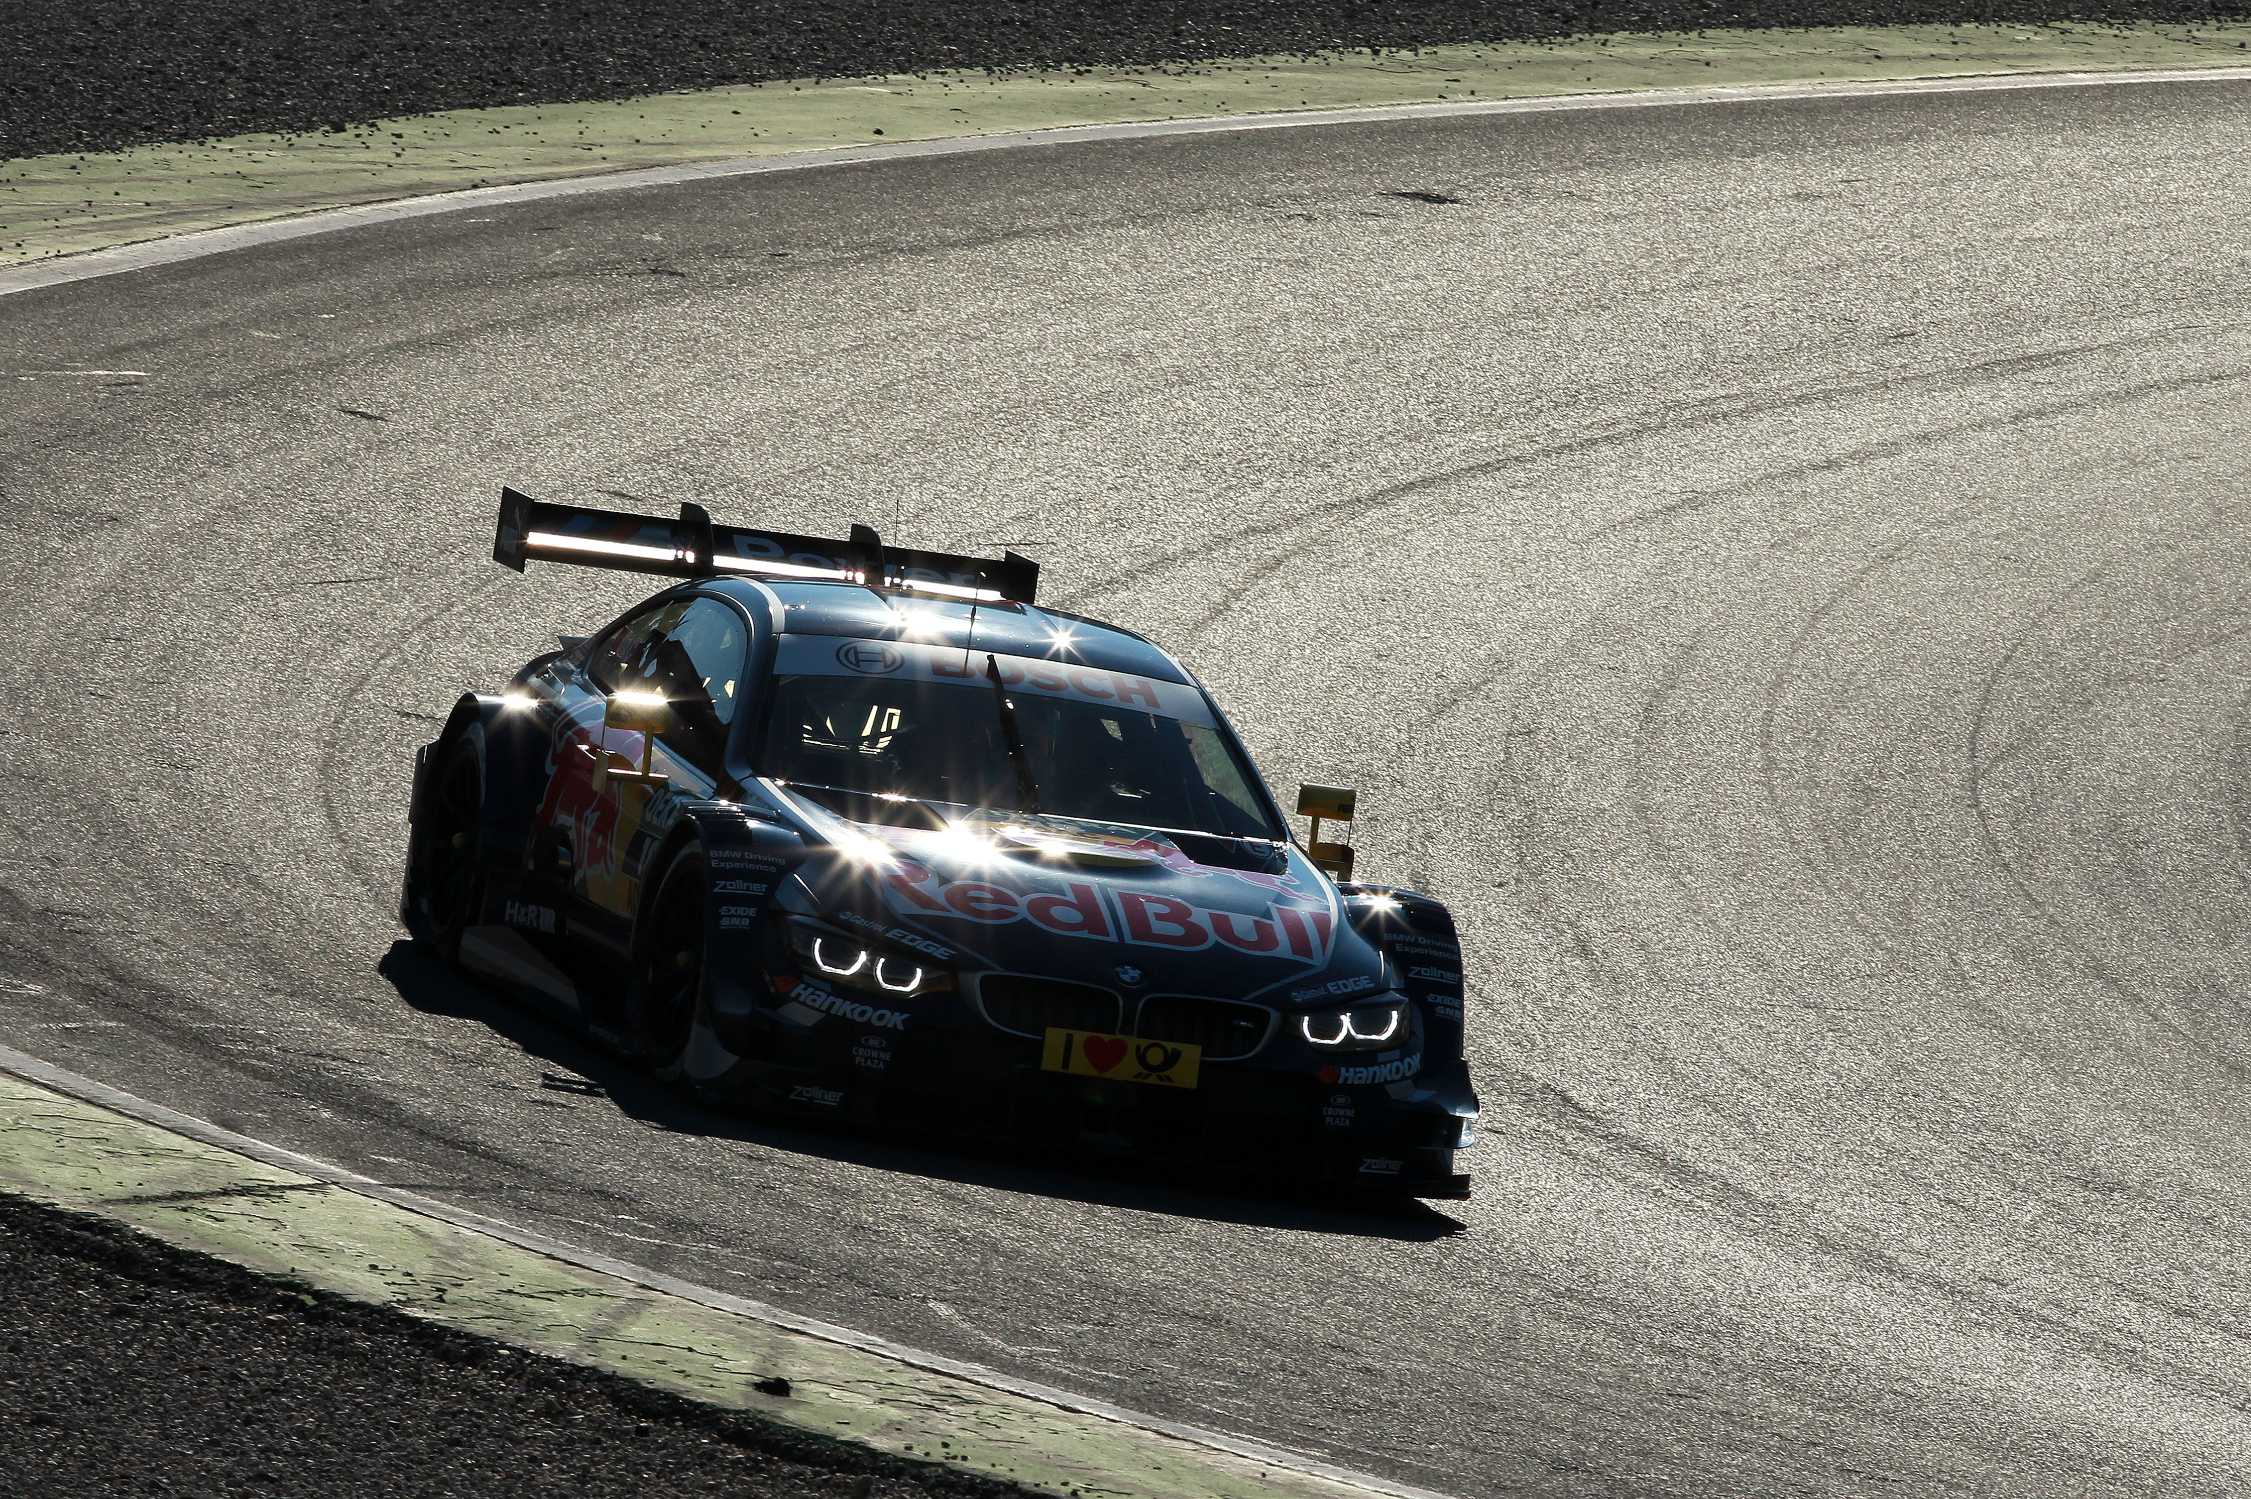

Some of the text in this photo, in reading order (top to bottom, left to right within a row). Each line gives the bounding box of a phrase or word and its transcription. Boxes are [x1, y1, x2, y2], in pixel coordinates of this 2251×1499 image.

[930, 655, 1161, 709] BOSCH
[884, 858, 1336, 966] Red Bull
